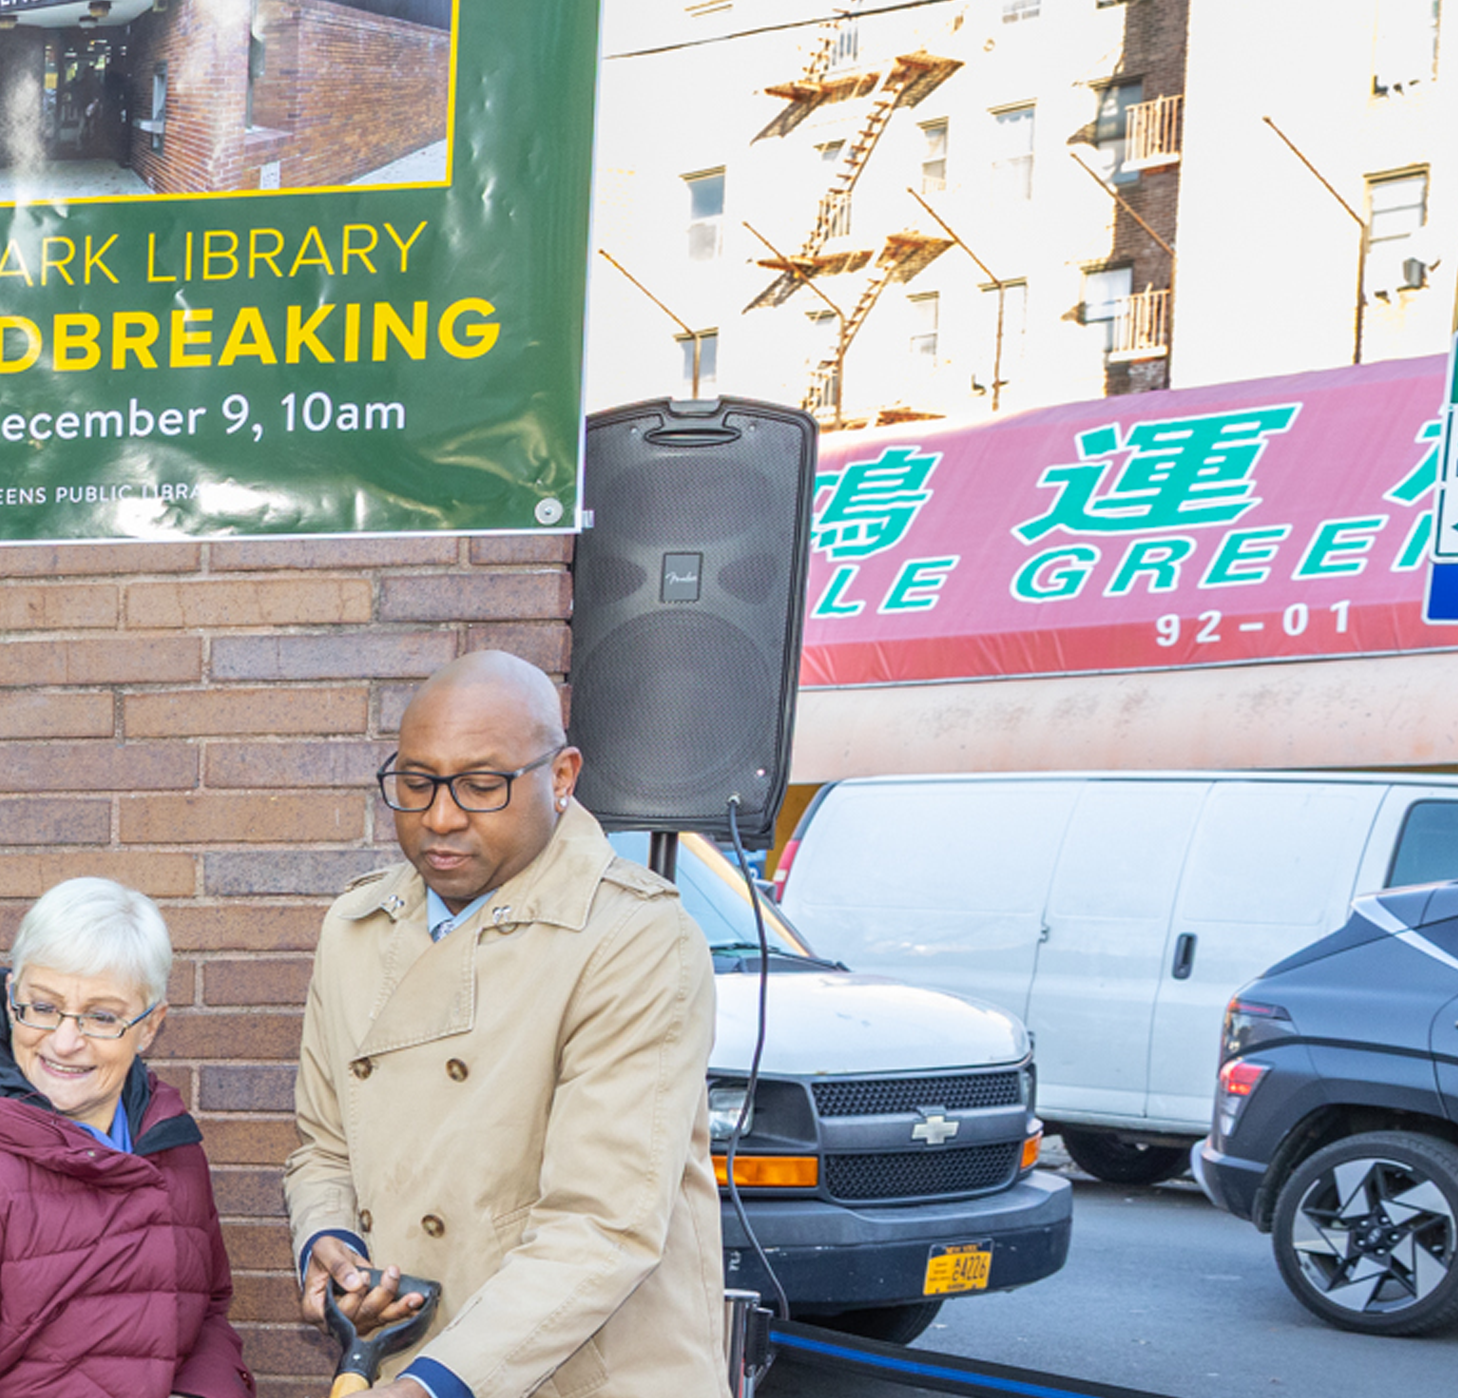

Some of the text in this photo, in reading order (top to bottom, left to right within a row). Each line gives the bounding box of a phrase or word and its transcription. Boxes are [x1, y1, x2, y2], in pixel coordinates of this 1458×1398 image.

[146, 220, 429, 283] LIBRARY
[221, 393, 264, 442] 9,
[280, 390, 407, 433] 10am
[55, 484, 132, 504] PUBLIC
[809, 510, 1433, 619] LE GREE
[1155, 599, 1352, 649] 92-01
